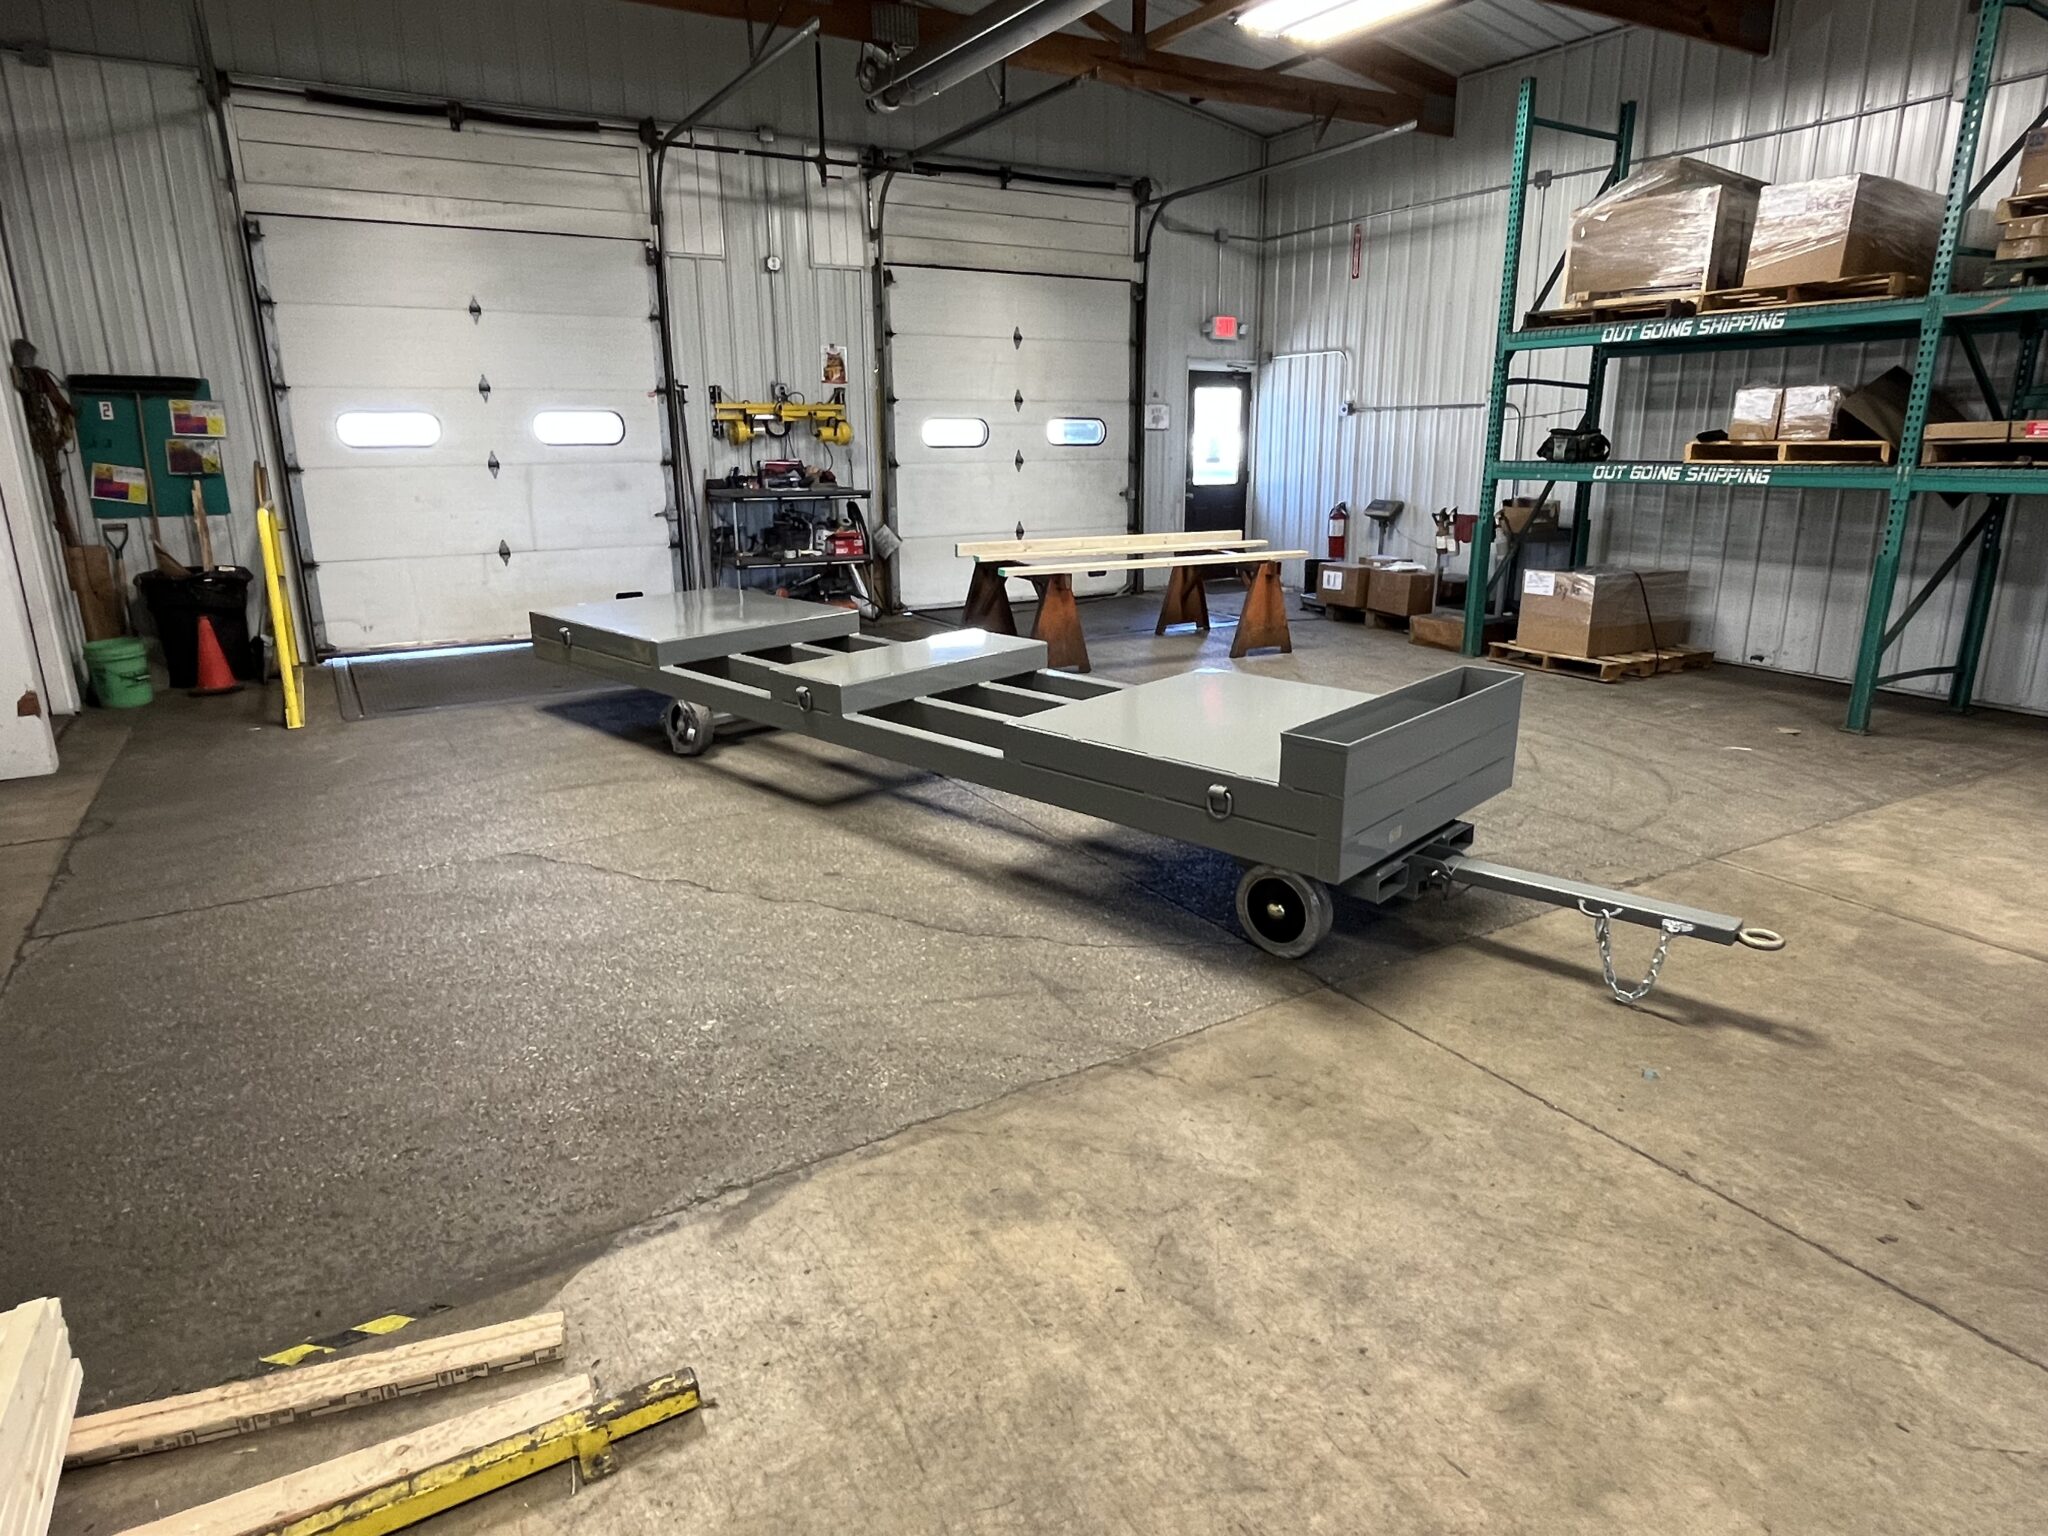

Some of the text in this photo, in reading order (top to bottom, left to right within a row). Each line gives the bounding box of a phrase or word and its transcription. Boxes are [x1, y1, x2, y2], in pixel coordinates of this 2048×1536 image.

[1601, 312, 1786, 343] OUT GOING SHIPPING
[102, 403, 111, 418] 2
[1592, 465, 1772, 484] OUT GOING SHIPPING
